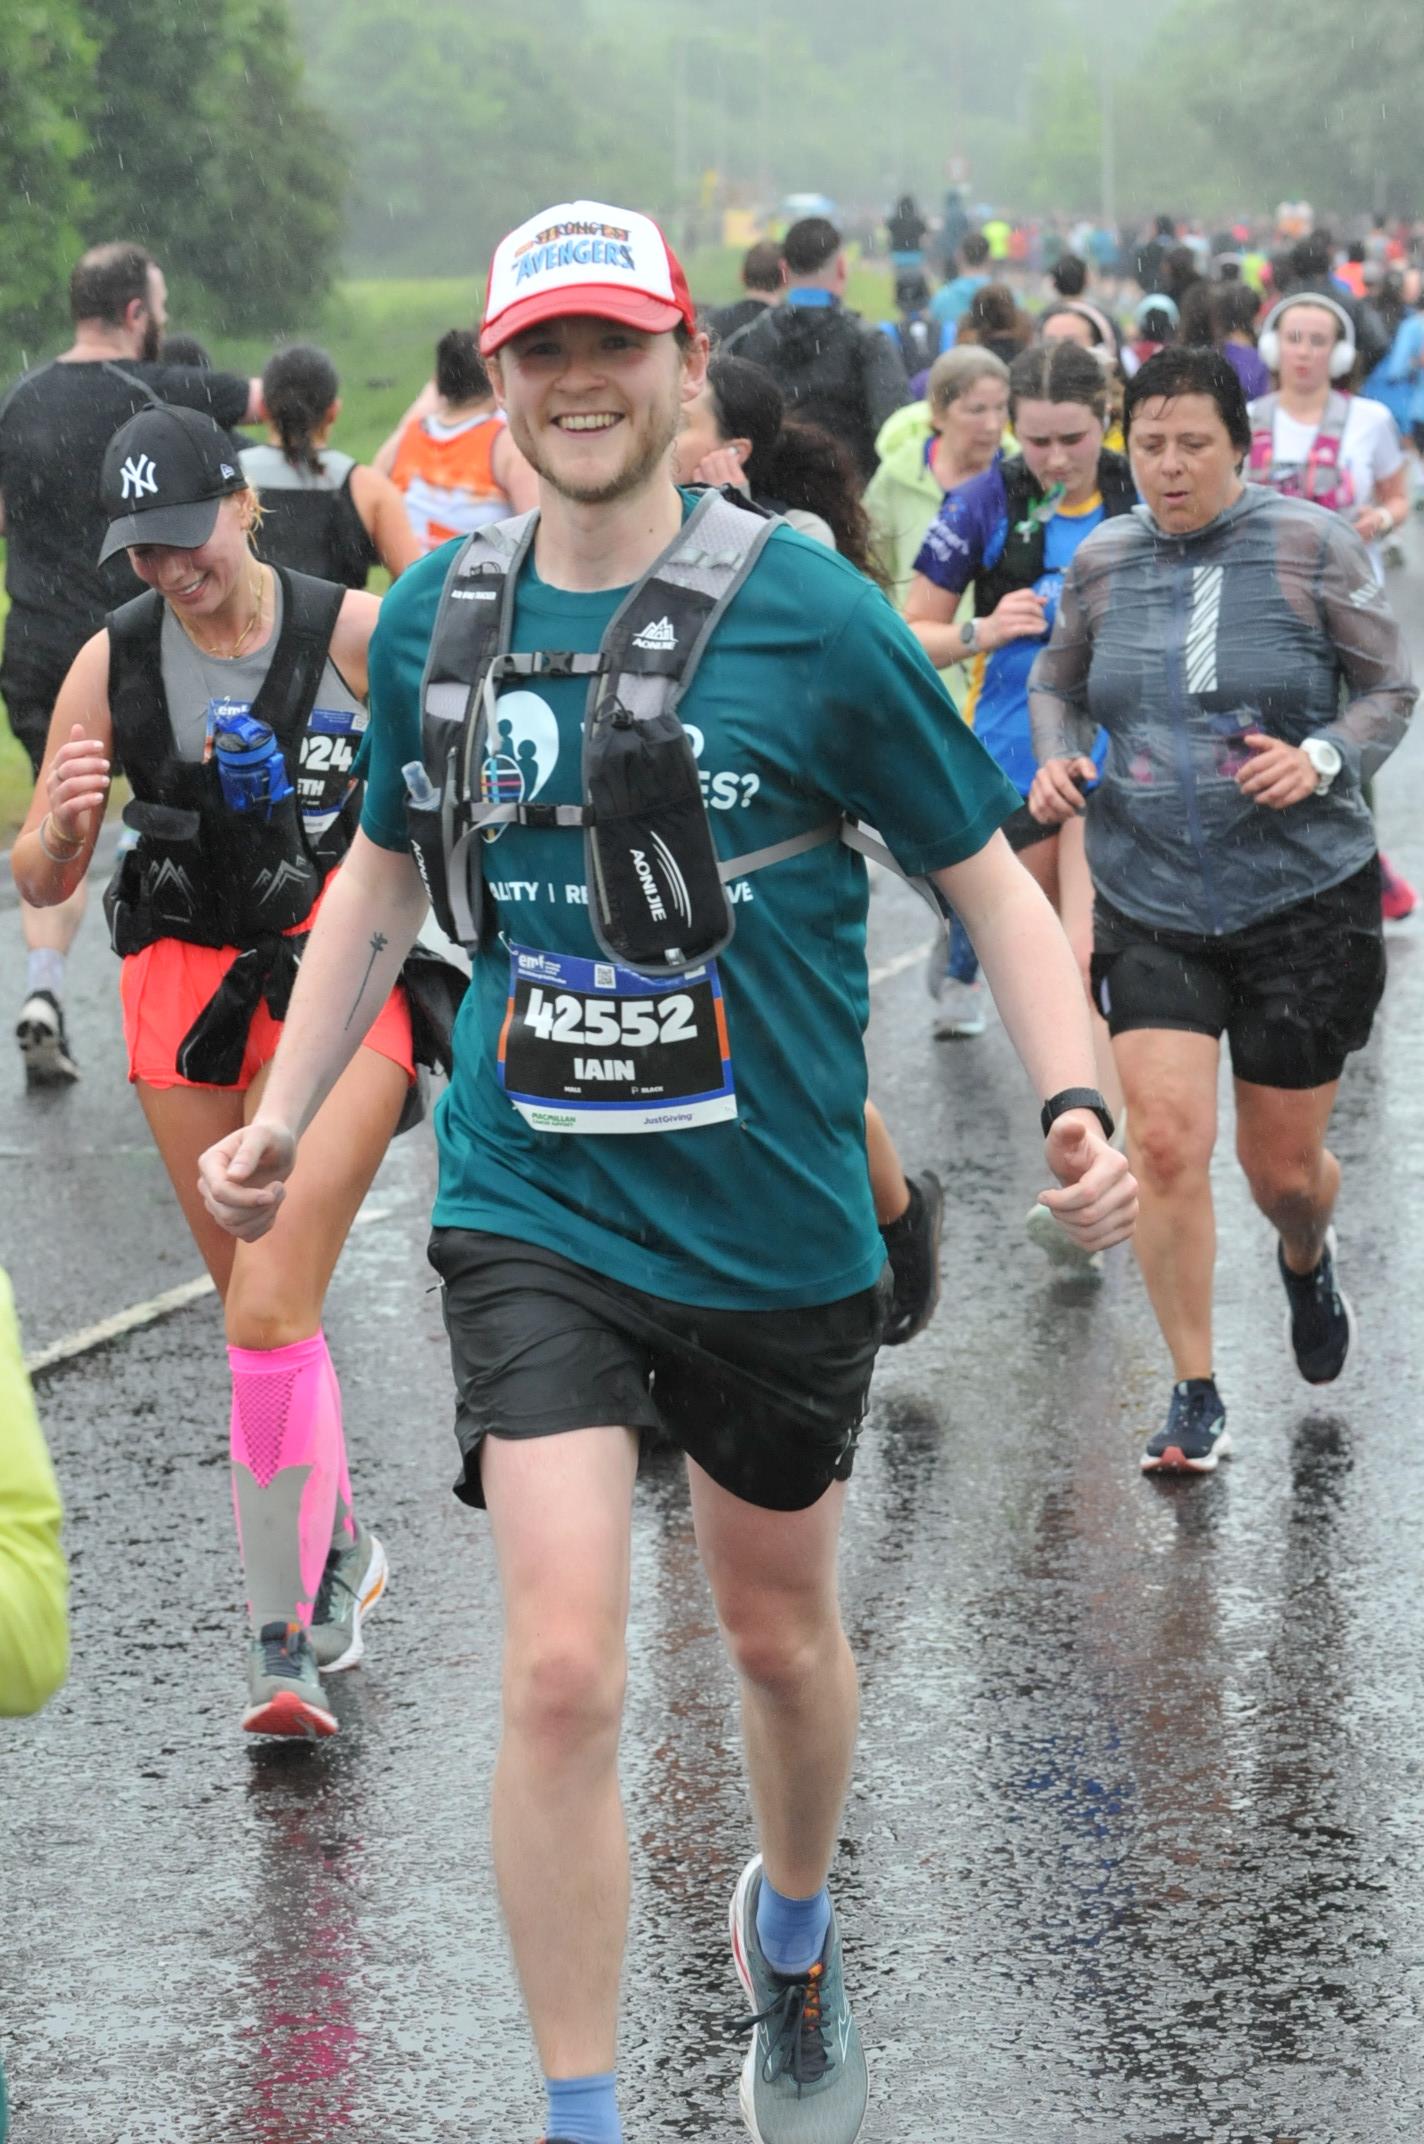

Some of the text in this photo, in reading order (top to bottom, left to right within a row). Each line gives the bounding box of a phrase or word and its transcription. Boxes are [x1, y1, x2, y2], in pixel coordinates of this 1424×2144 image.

[511, 240, 636, 286] AVENGERS
[120, 454, 159, 499] NY
[411, 839, 433, 904] AONIIE
[630, 849, 667, 922] AONIJIE
[518, 954, 544, 968] emf
[524, 988, 698, 1047] 42552
[574, 1057, 636, 1081] IAIN
[532, 1112, 576, 1123] MACMILLAN
[644, 1113, 693, 1125] JustGiving
